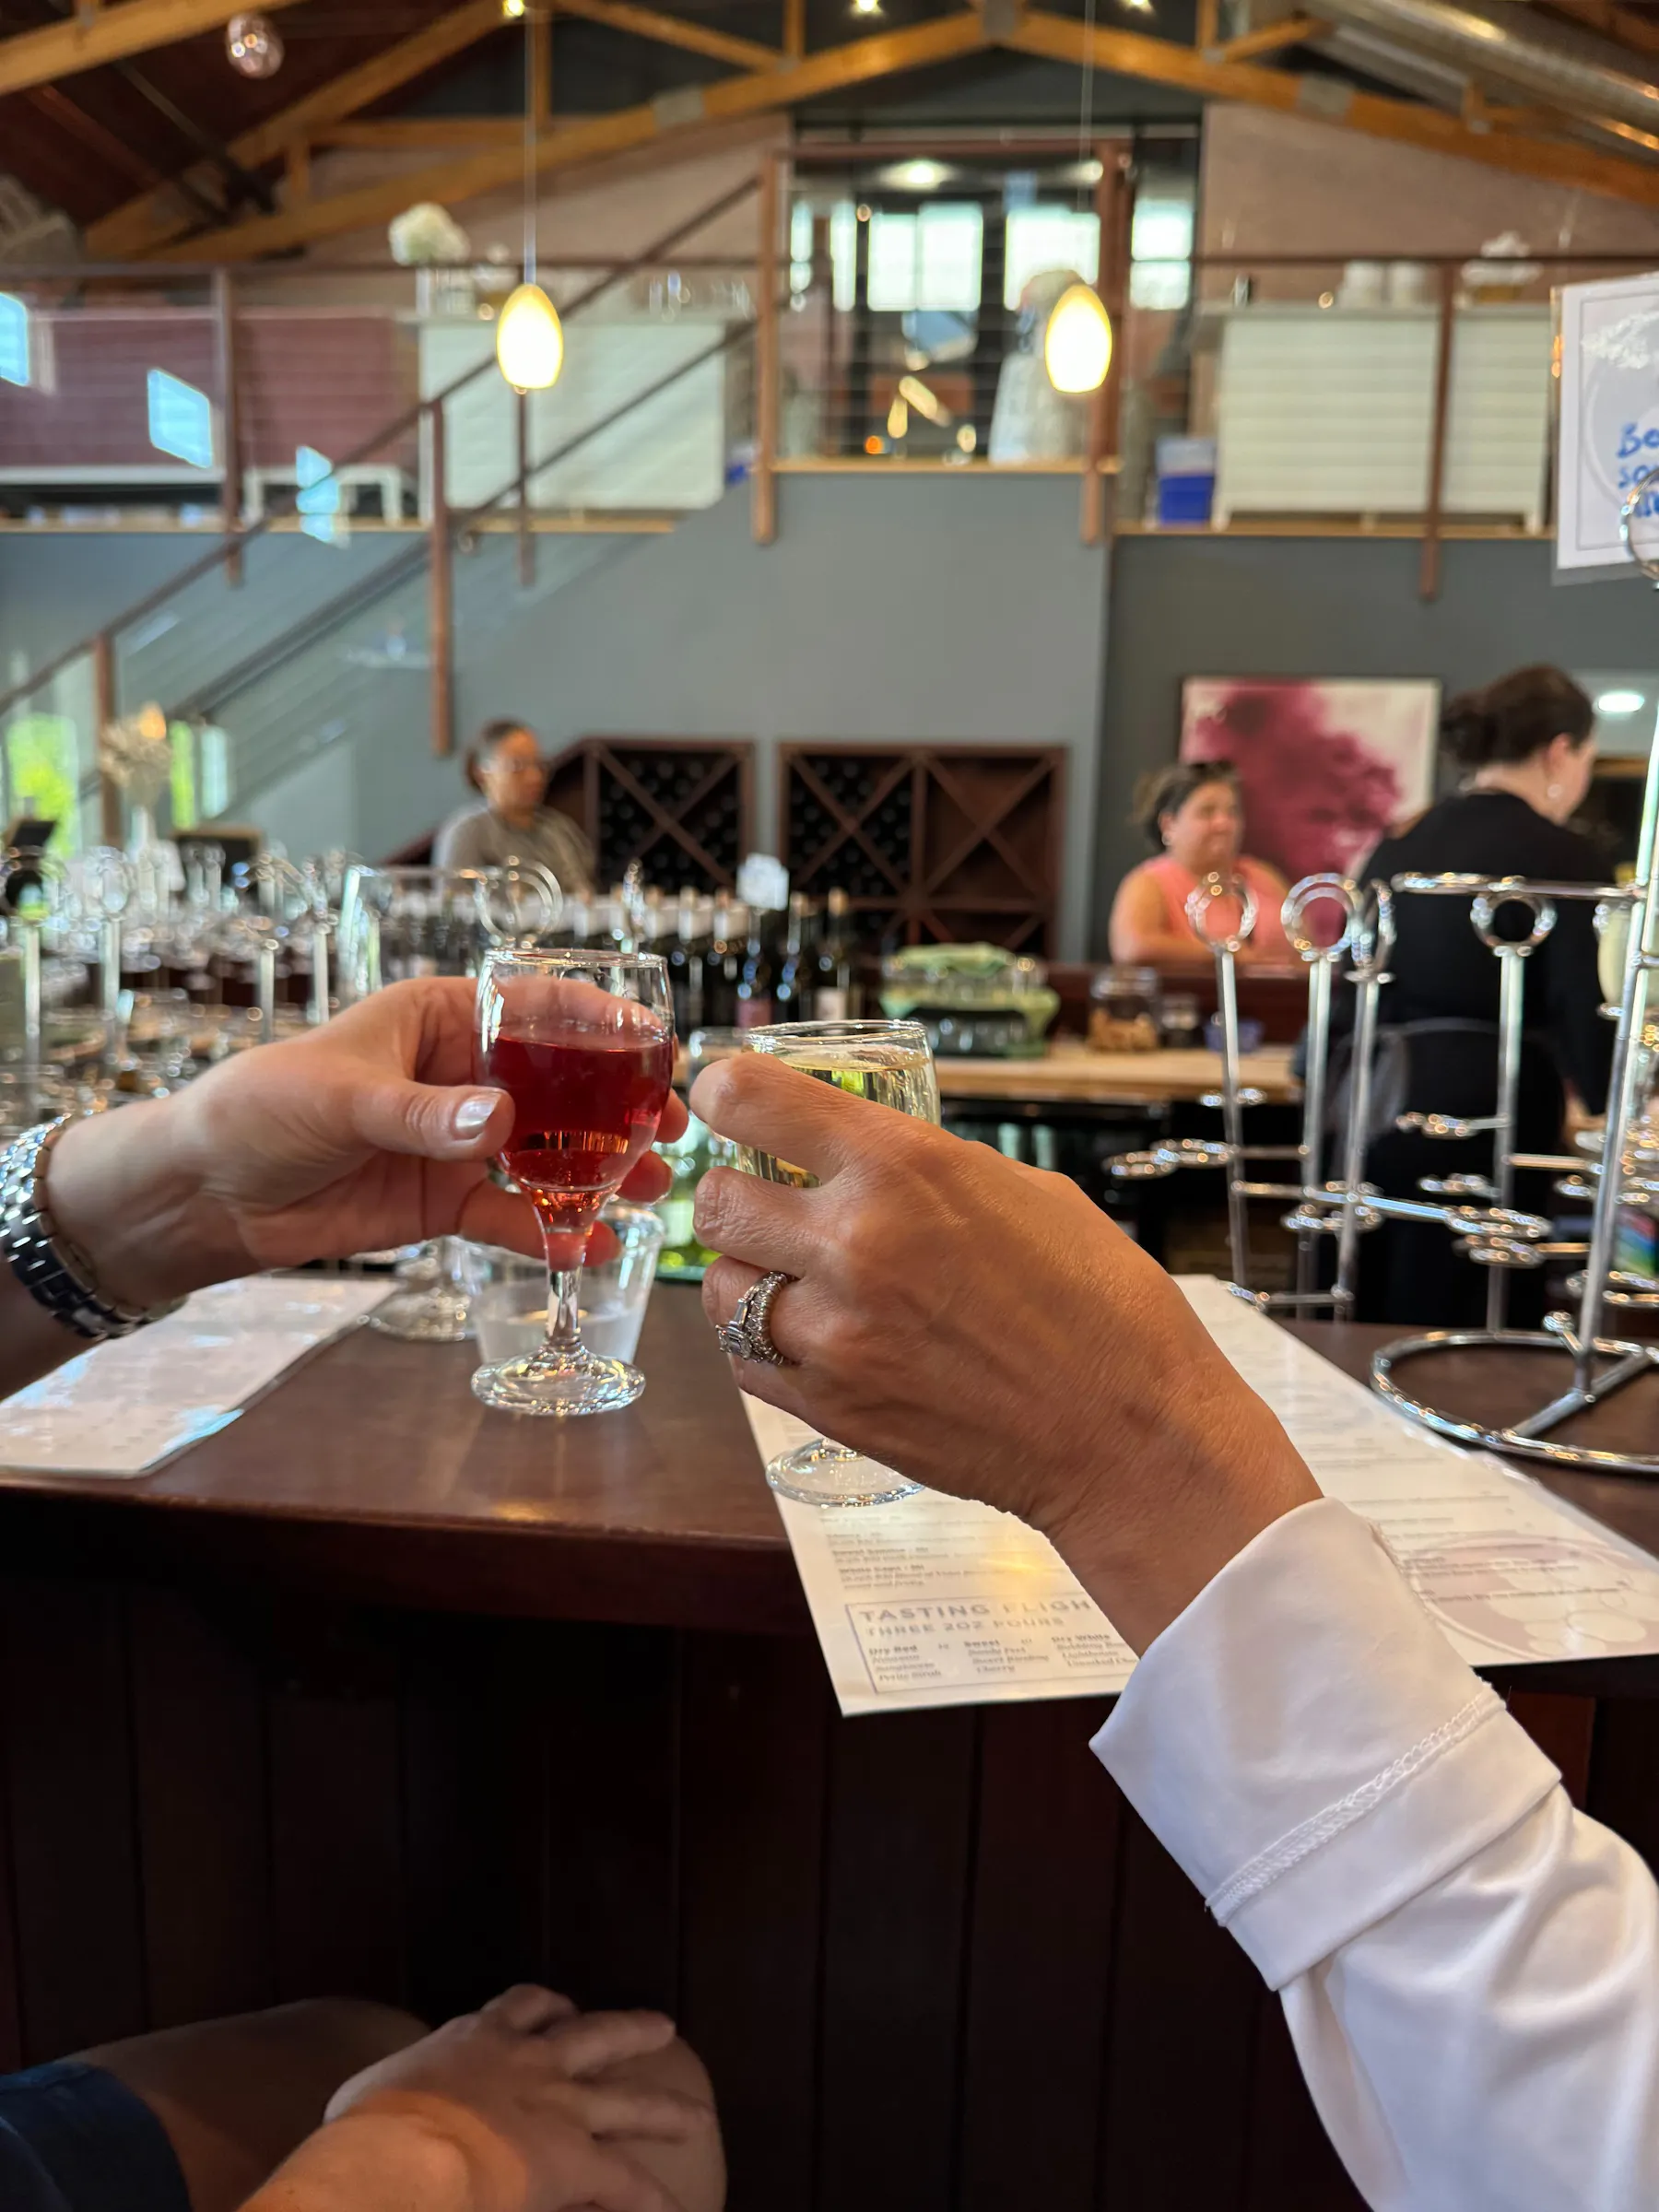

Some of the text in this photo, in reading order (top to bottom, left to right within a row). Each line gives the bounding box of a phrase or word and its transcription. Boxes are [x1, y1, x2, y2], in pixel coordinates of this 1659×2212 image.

[858, 1599, 1093, 1623] TASTING FLIGH
[866, 1622, 937, 1638] THREE
[994, 1617, 1065, 1630] POURS
